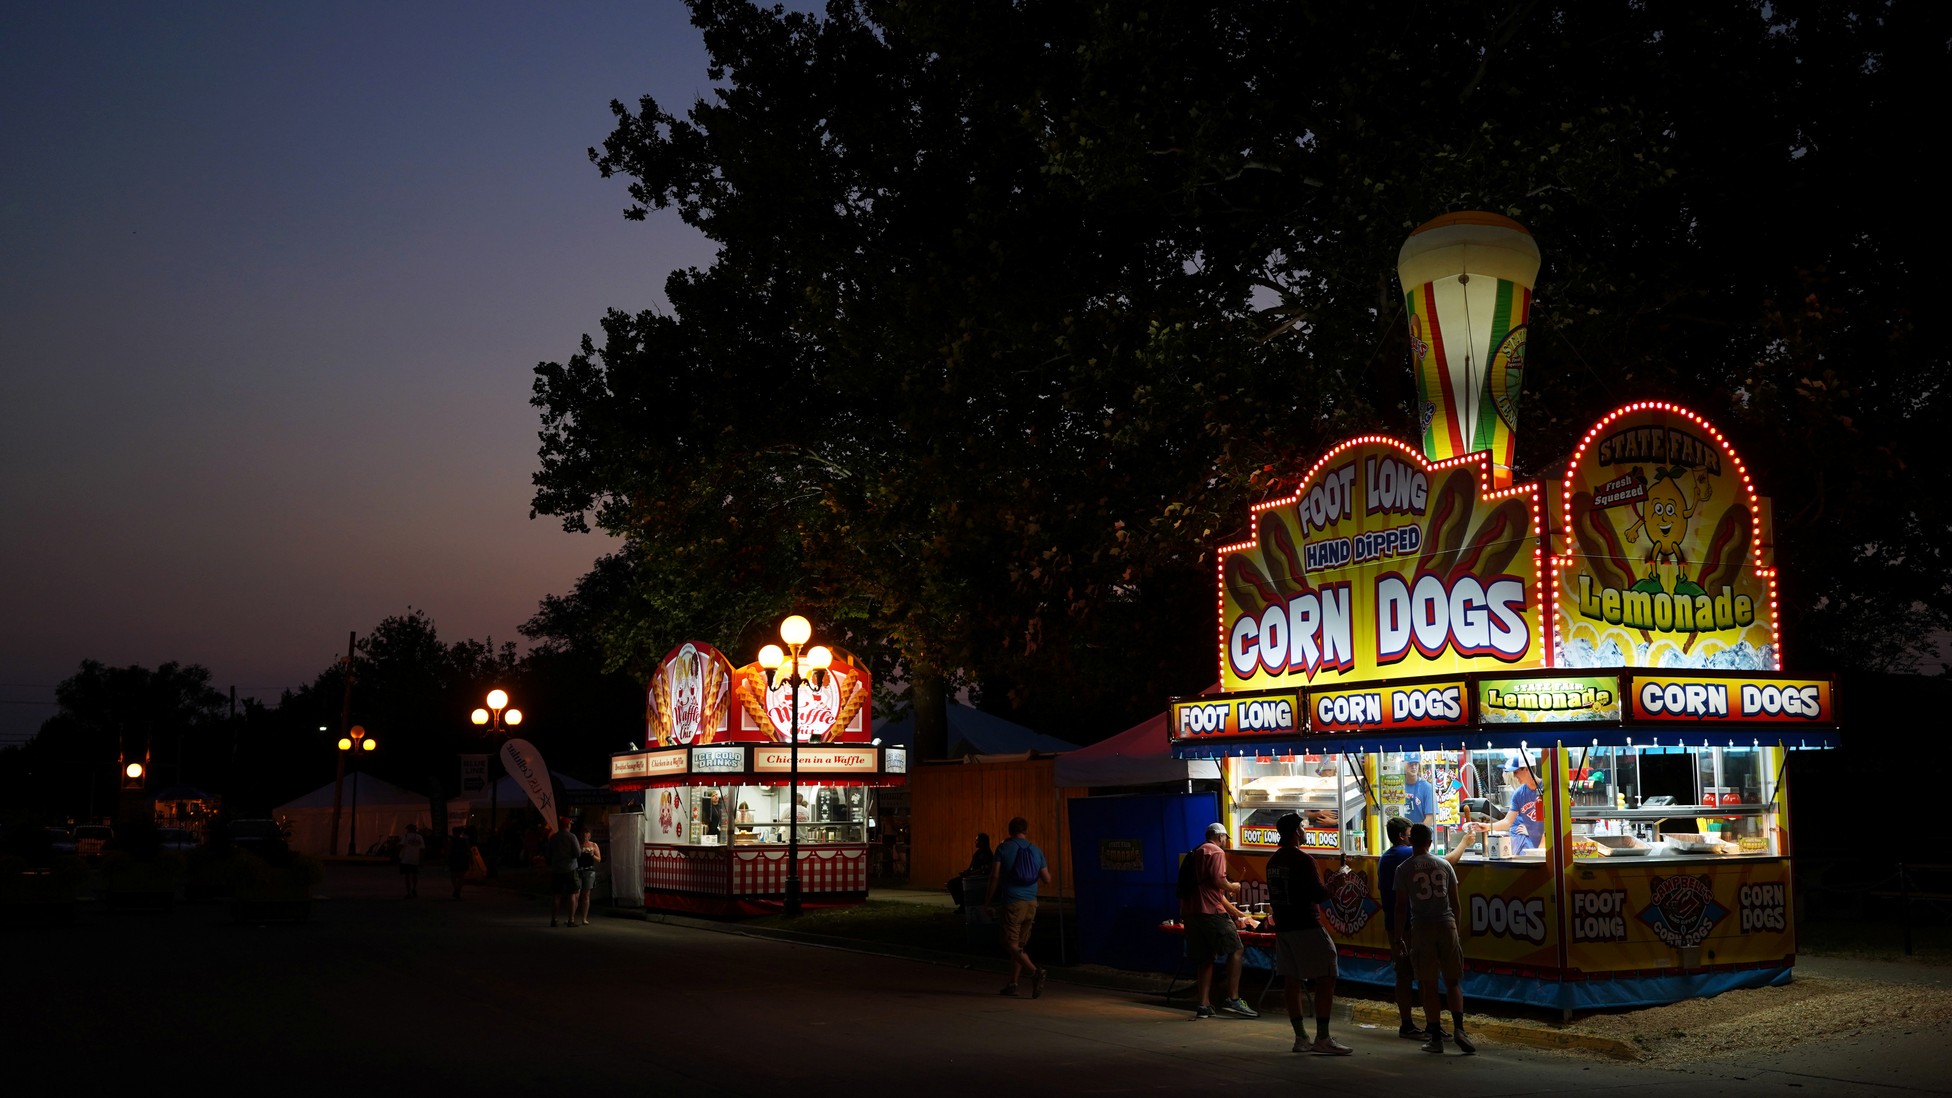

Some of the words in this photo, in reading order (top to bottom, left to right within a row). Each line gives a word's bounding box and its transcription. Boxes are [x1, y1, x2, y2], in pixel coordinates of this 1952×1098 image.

[1600, 425, 1666, 466] STATE
[1668, 428, 1721, 476] FAIR
[1299, 462, 1355, 535] FOOT
[1366, 457, 1427, 515] LONG
[1594, 485, 1644, 505] Squeezed
[1606, 477, 1632, 492] Fresh
[1305, 537, 1351, 571] HAND
[1579, 575, 1754, 632] Lemonade
[1229, 584, 1353, 678] CORN
[1377, 574, 1530, 662] DOGS
[1317, 692, 1382, 726] CORN
[1392, 686, 1462, 722] DOGS
[1488, 687, 1612, 711] Lemonade
[1642, 684, 1728, 719] CORN
[1741, 683, 1821, 718] DOGS
[1180, 703, 1230, 733] FOOT
[1238, 699, 1293, 731] LONG
[695, 752, 712, 763] ICE
[715, 751, 741, 761] COLD
[699, 759, 739, 769] DRINKS
[766, 755, 811, 764] Chicen
[813, 756, 823, 764] in
[833, 755, 865, 766] Waffle
[1243, 829, 1261, 843] FOOT
[1264, 830, 1281, 845] LONG
[1306, 832, 1316, 846] RN
[1319, 833, 1338, 847] DOGS
[1413, 870, 1448, 900] 39
[1740, 884, 1785, 907] CORN
[1573, 891, 1626, 914] FOOT
[1348, 909, 1368, 934] DOGS
[1470, 896, 1546, 945] DOGS
[1574, 916, 1625, 940] LONG
[1653, 921, 1682, 946] CORN
[1685, 917, 1713, 945] DOGS
[1741, 907, 1786, 932] DOGS
